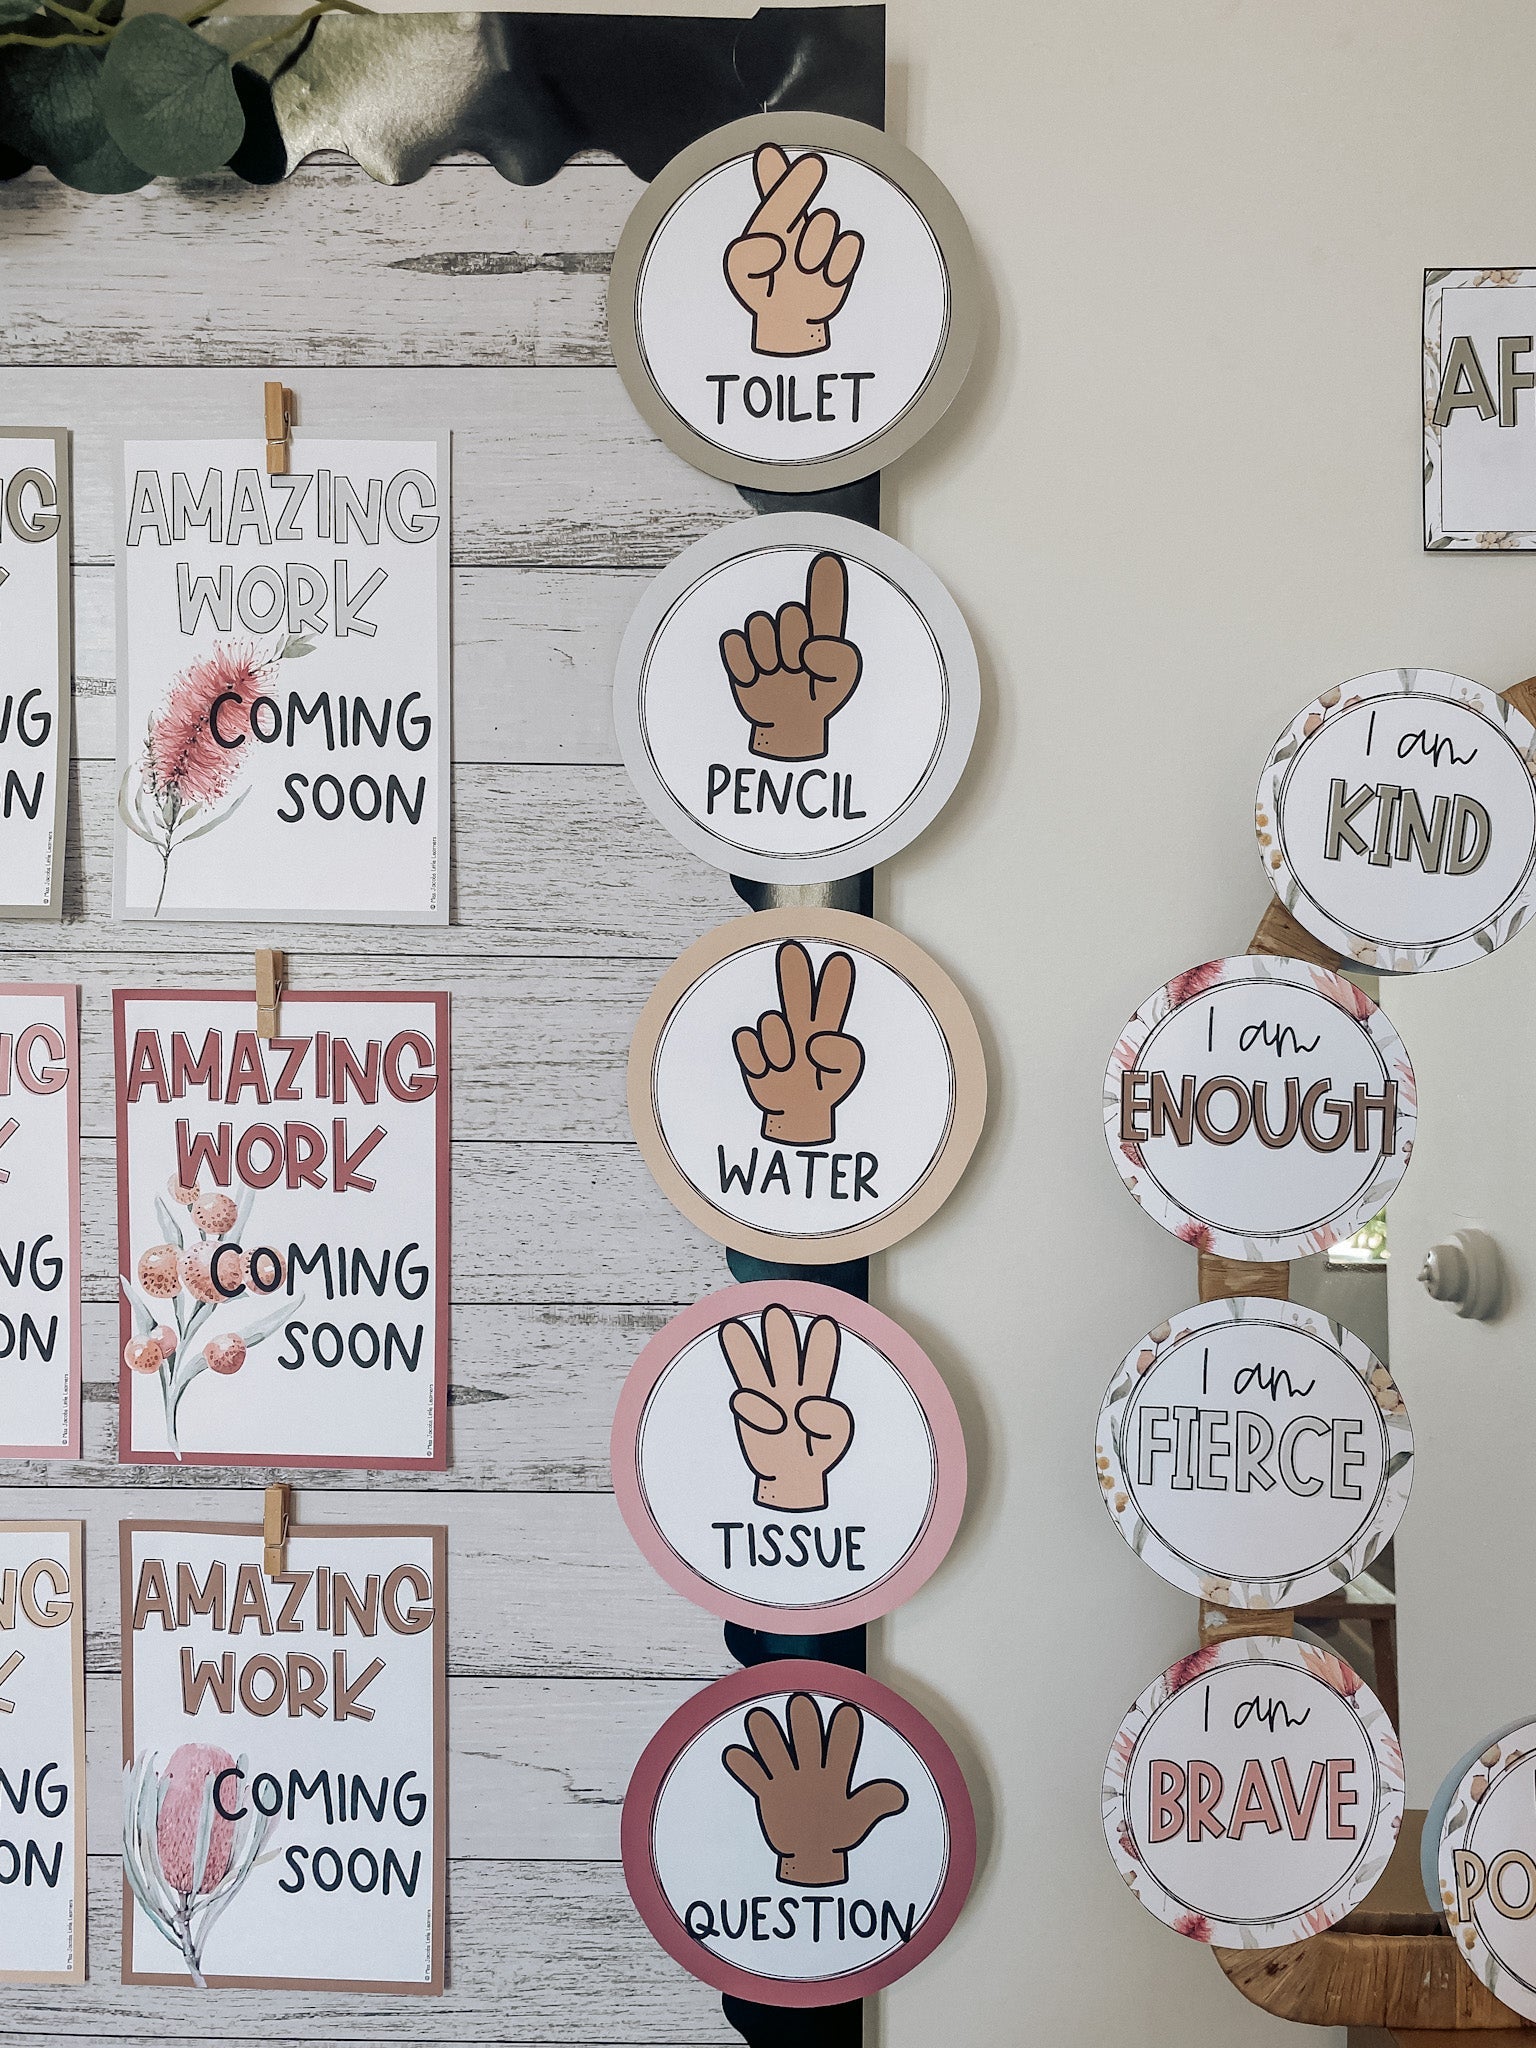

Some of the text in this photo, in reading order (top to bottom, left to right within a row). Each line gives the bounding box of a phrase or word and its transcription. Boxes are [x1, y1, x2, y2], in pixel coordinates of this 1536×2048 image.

[705, 372, 875, 424] TOILET
[1432, 335, 1536, 428] AF
[0, 466, 62, 544] G
[126, 467, 440, 546] AMAZING
[176, 559, 389, 637] WORK
[209, 690, 432, 752] COMING
[1366, 711, 1478, 768] I am
[278, 773, 426, 824] SOON
[706, 763, 867, 820] PENCIL
[1324, 778, 1492, 875] KIND
[1207, 1006, 1321, 1058] I am
[126, 1027, 440, 1105] AMAZING
[1119, 1070, 1399, 1157] ENOUGH
[174, 1117, 388, 1193] WORK
[717, 1144, 879, 1202] WATER
[209, 1242, 430, 1301] COMING
[277, 1321, 424, 1373] SOON
[1202, 1347, 1316, 1401] I am
[1137, 1405, 1365, 1500] FIERCE
[711, 1522, 866, 1571] TISSUE
[133, 1559, 436, 1637] AMAZING
[179, 1646, 386, 1722] WORK
[1203, 1685, 1311, 1733] I am
[212, 1767, 428, 1828] COMING
[1148, 1756, 1359, 1844] BRAVE
[278, 1845, 422, 1898] SOON
[1453, 1848, 1536, 1922] PO
[684, 1896, 916, 1943] QUESTION
